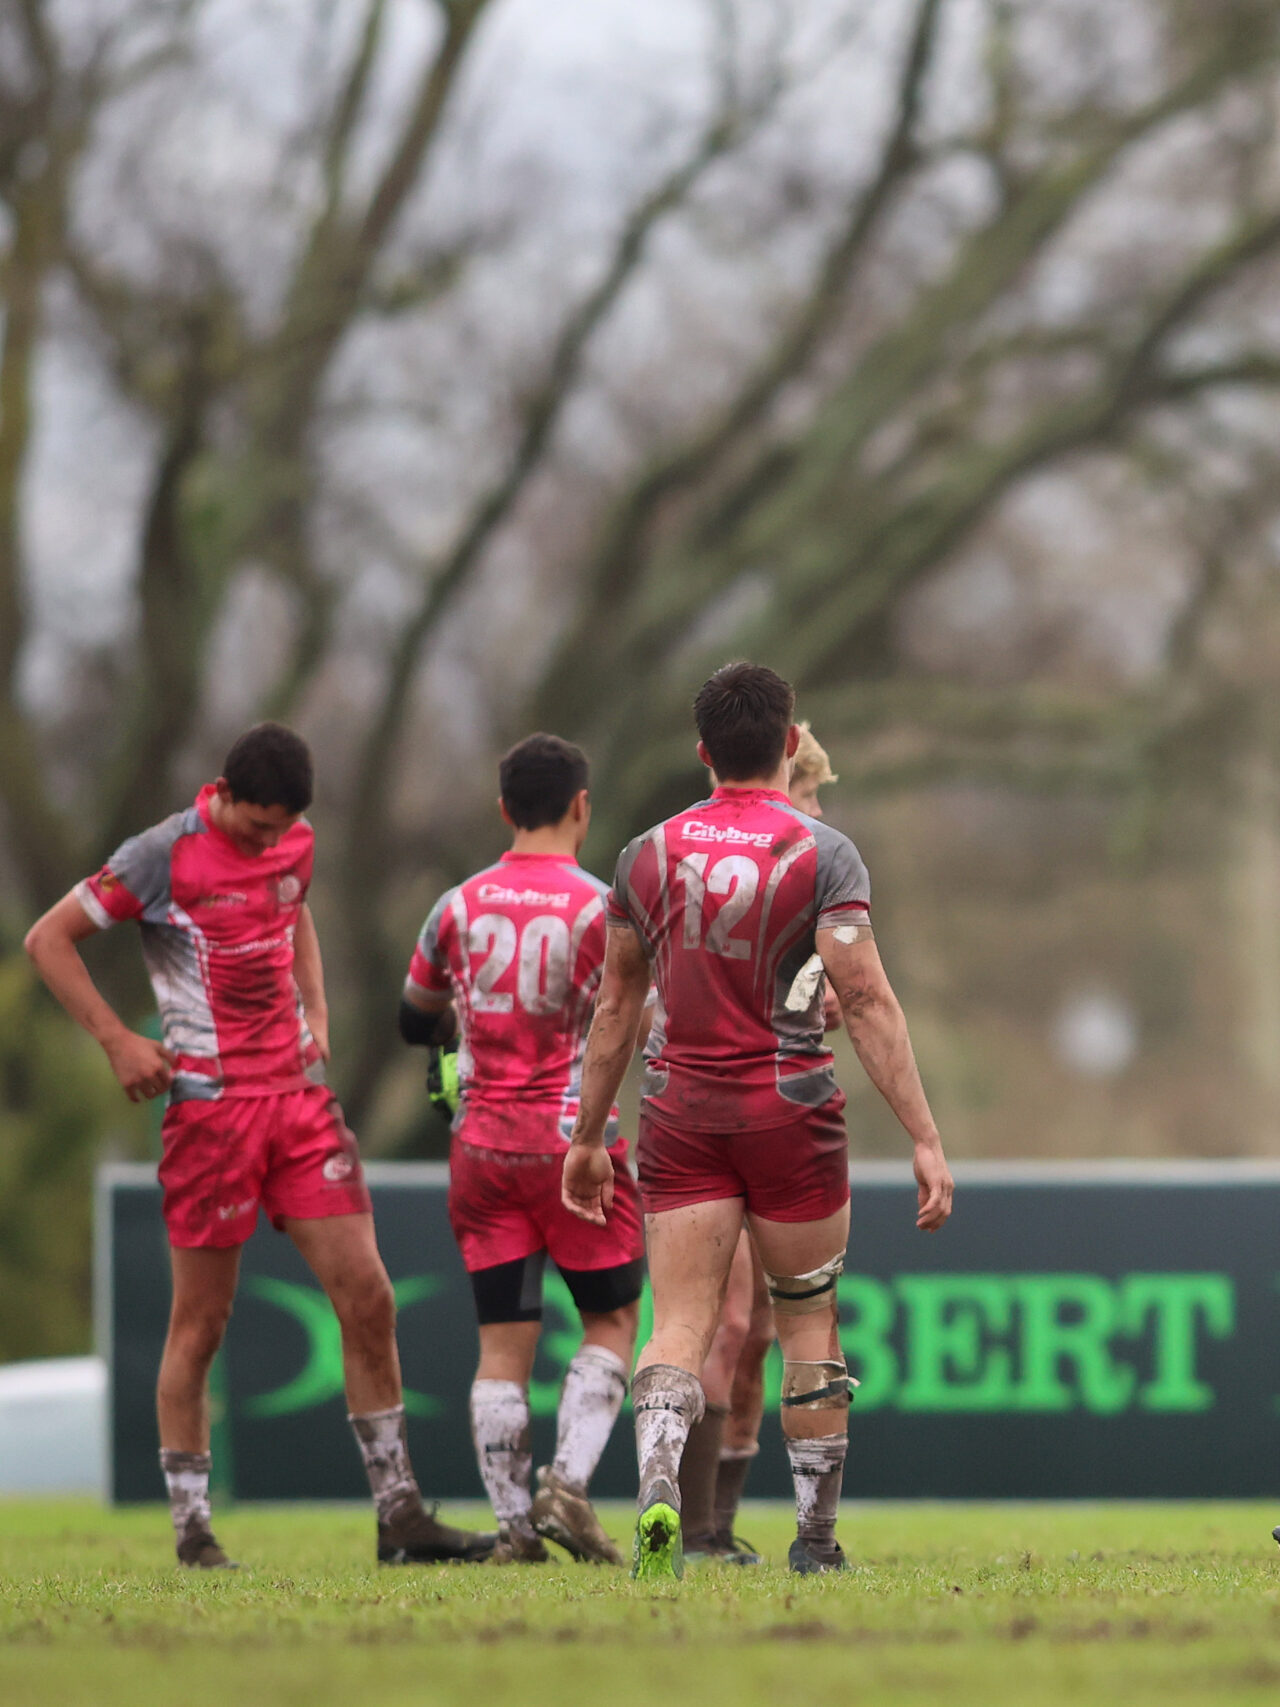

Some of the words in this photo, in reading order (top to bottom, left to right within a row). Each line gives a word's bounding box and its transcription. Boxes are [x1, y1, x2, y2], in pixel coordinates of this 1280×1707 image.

[681, 821, 775, 848] Citybug
[675, 852, 760, 960] 12
[470, 913, 571, 1016] 20
